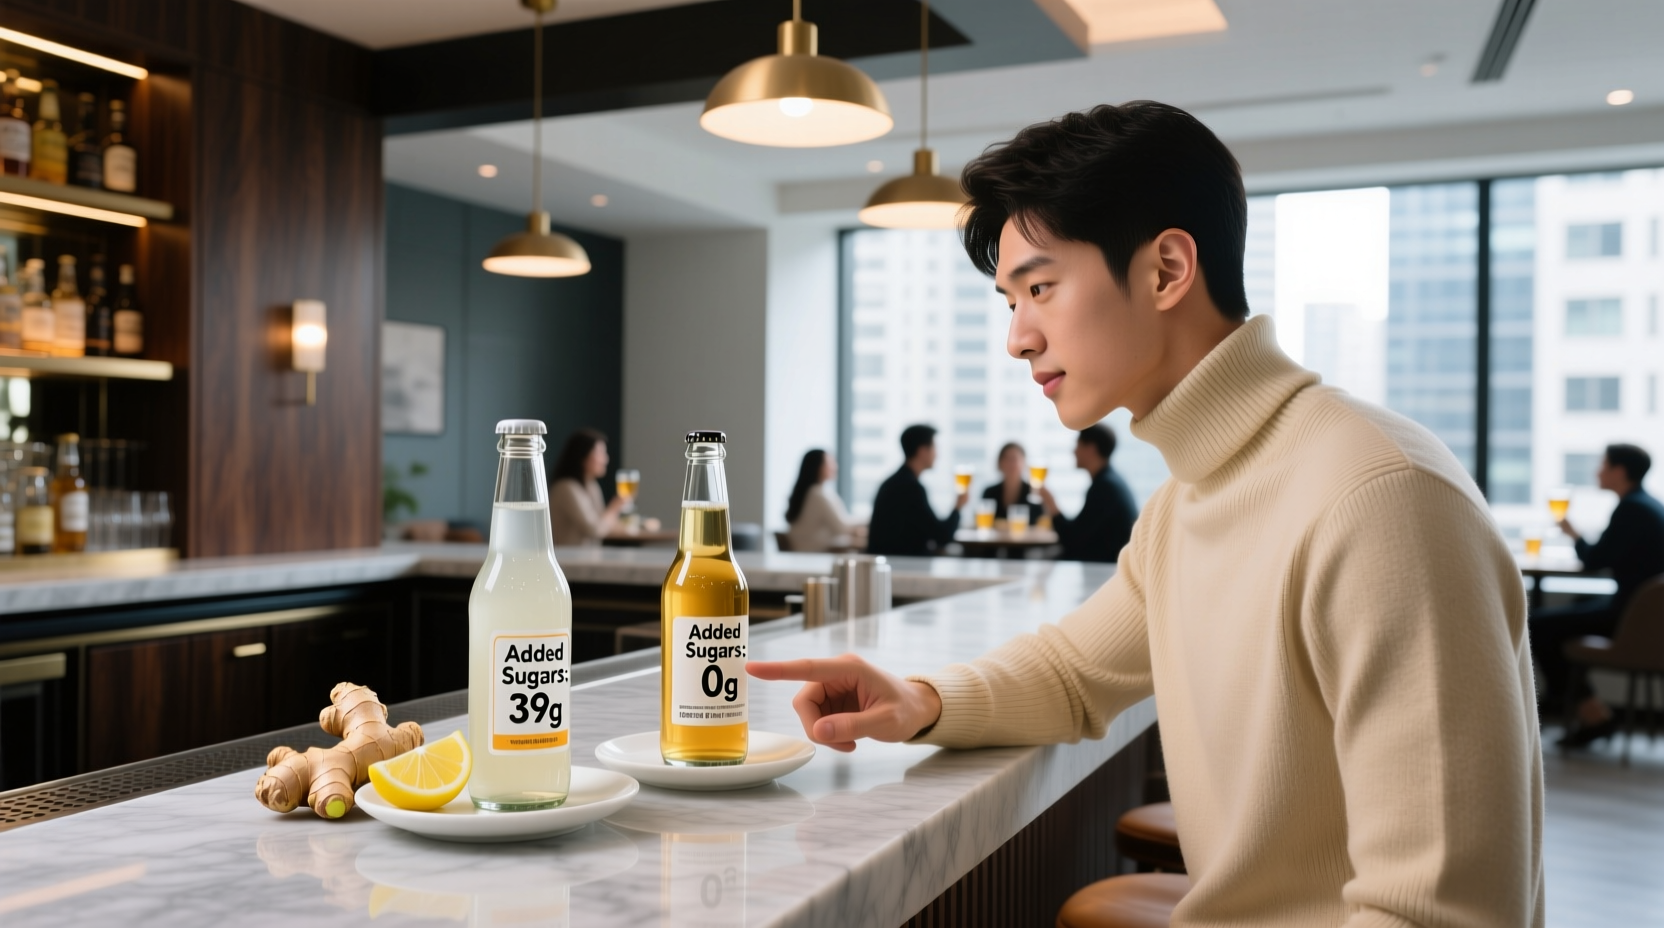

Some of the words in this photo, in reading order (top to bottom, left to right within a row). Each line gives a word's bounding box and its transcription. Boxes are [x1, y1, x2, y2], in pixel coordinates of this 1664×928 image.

[688, 622, 741, 640] Added
[504, 641, 564, 663] Added
[685, 641, 746, 663] Sugars:
[701, 664, 738, 702] 0g
[509, 692, 562, 729] 39g
